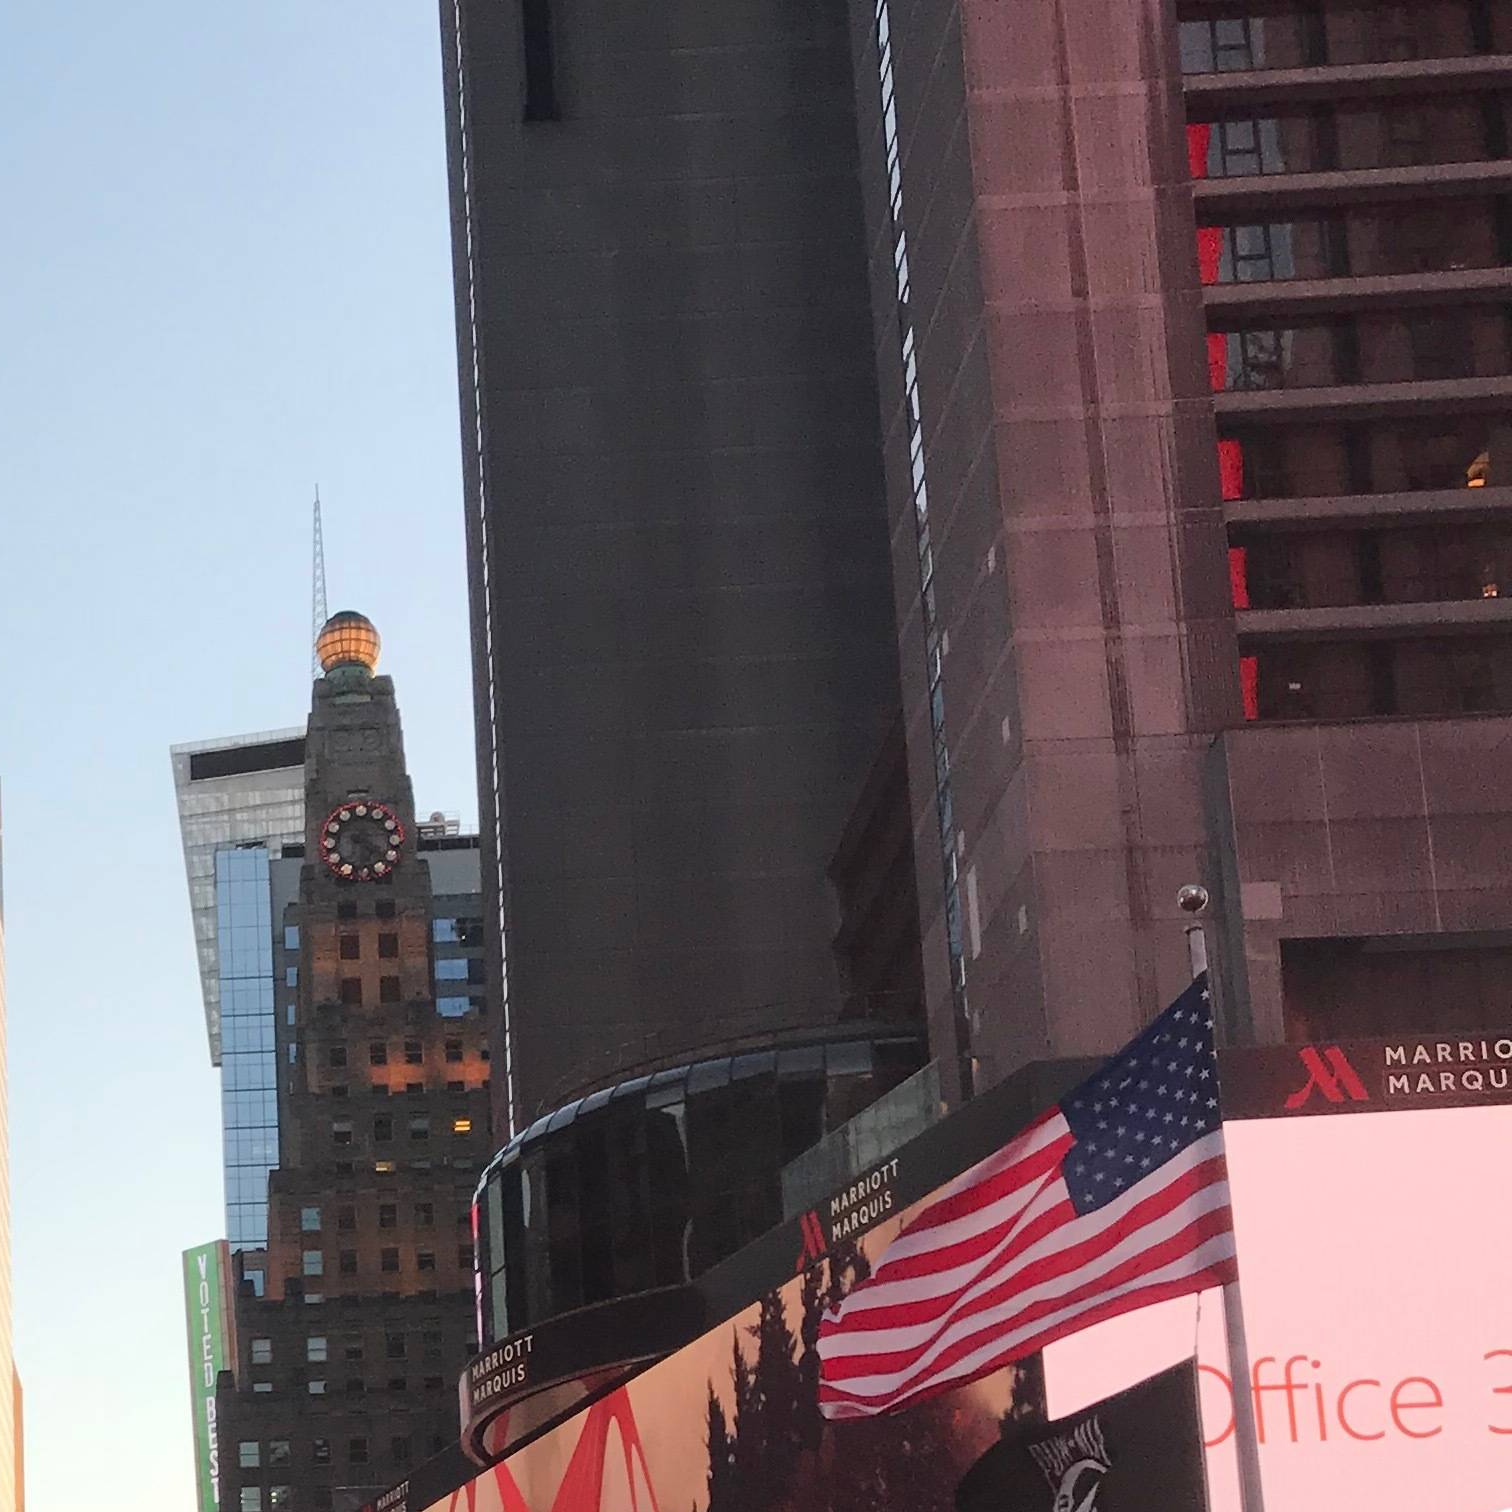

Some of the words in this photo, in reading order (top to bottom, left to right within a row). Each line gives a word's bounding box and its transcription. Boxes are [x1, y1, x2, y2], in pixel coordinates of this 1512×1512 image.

[831, 1158, 899, 1216] MARRIOTT
[832, 1191, 892, 1242] MARQUIS
[197, 1253, 214, 1388] VOTED
[472, 1335, 533, 1382] MARRIOTT
[473, 1363, 526, 1406] MARQUIS
